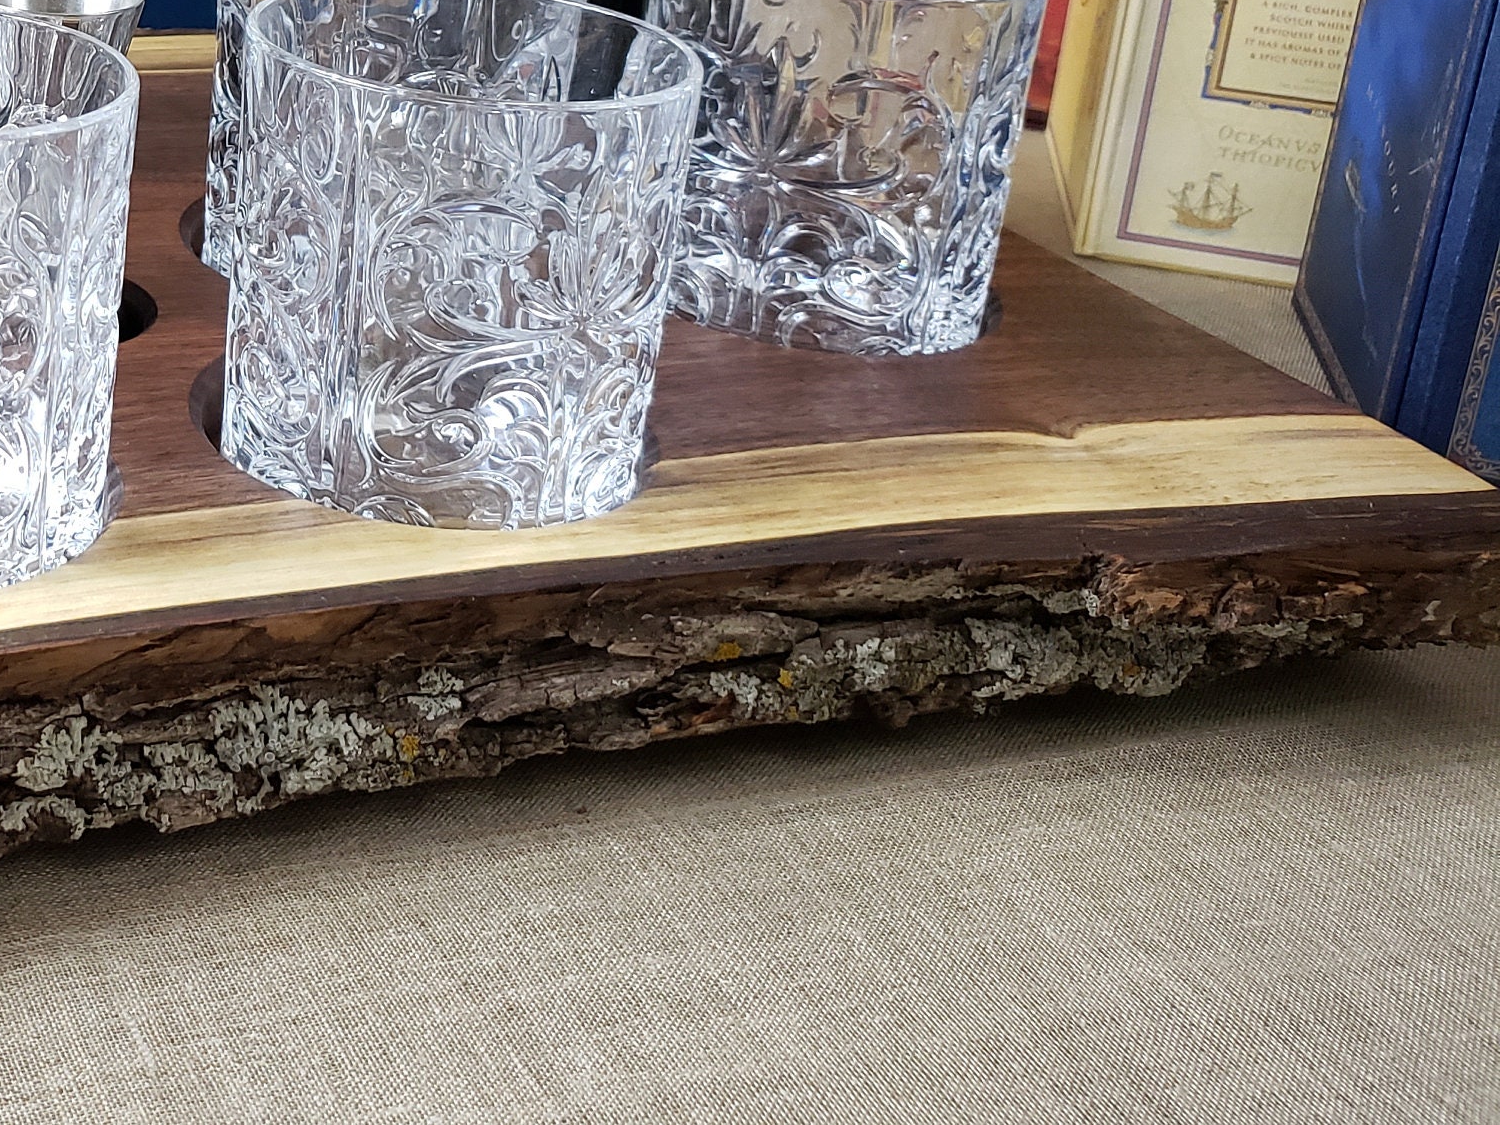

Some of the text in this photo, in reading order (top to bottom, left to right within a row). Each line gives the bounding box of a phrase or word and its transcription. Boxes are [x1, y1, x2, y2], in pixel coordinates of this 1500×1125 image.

[1270, 14, 1313, 27] SCOTCH
[1253, 26, 1345, 44] PREVIOUSLY USED
[1258, 39, 1278, 48] HAS
[1283, 42, 1324, 55] AROMAS
[1327, 48, 1341, 57] OF
[1291, 58, 1325, 69] NOTES
